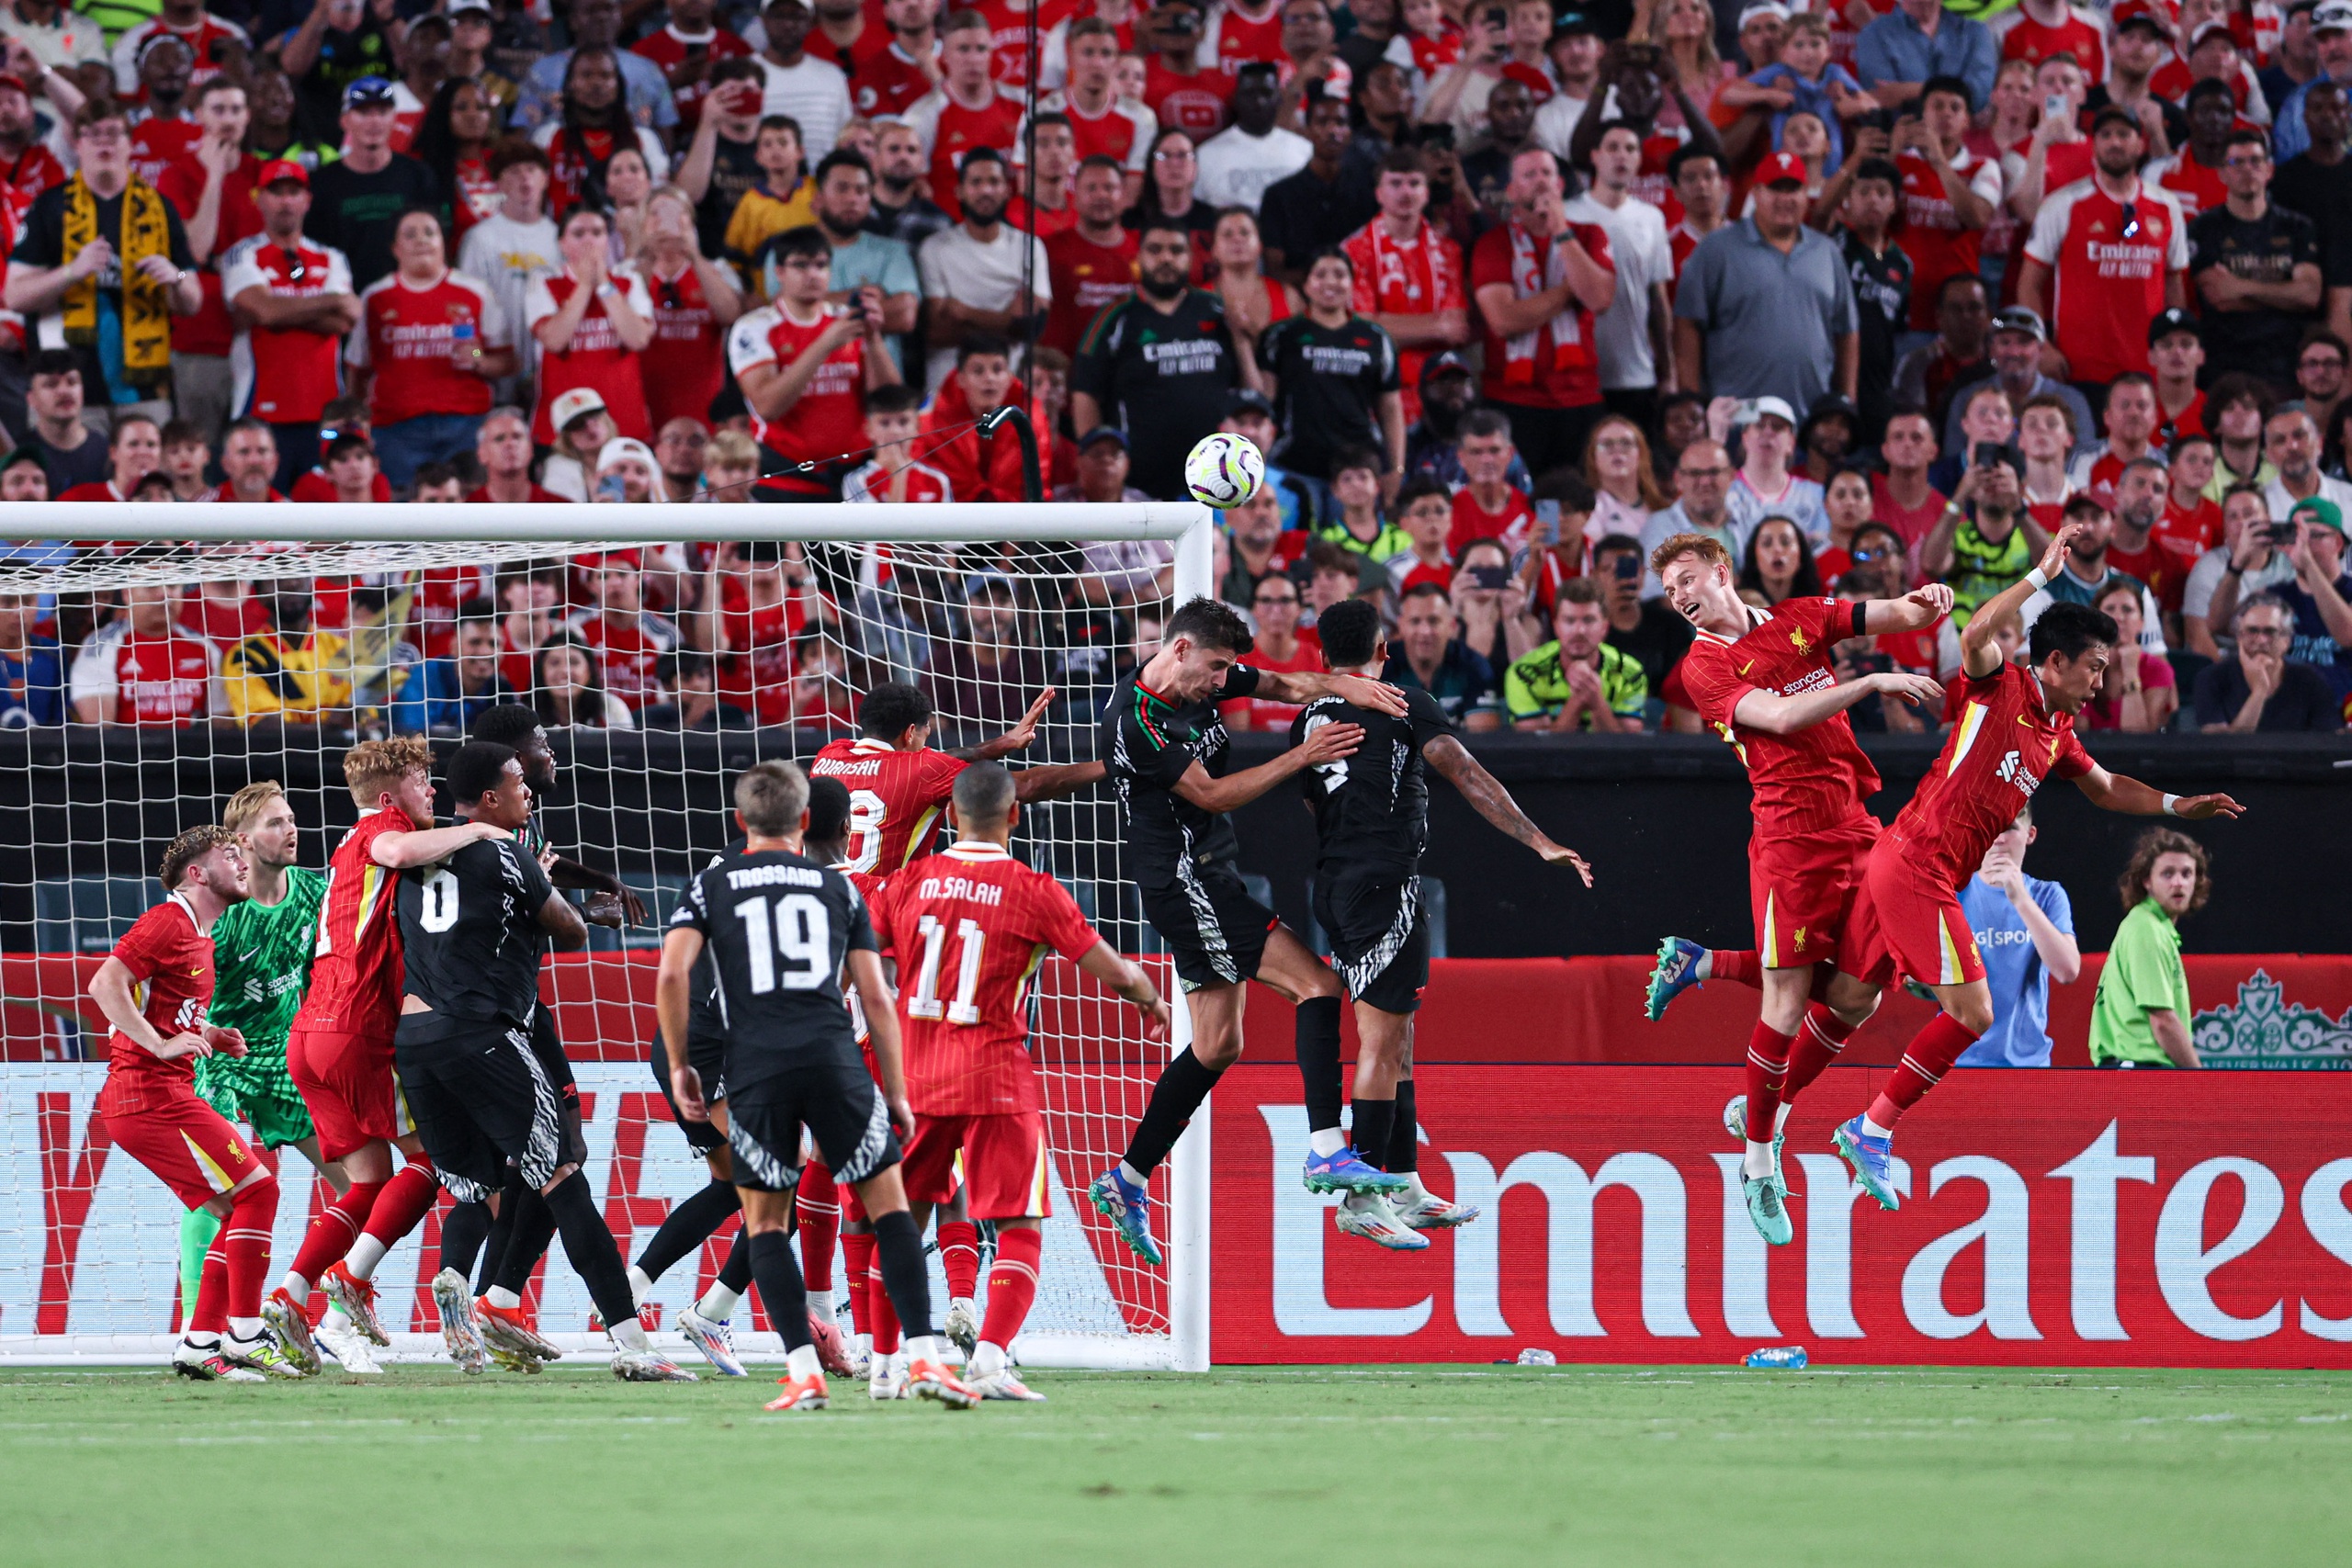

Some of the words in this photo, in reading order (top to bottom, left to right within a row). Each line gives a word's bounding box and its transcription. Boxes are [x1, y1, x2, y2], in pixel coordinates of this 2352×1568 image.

[2086, 241, 2162, 263] Emirates
[811, 757, 882, 777] QUANSAH
[726, 864, 825, 890] TROSSARD
[919, 876, 1003, 907] M.SALAH
[734, 893, 832, 995] 19
[907, 915, 987, 1025] 11
